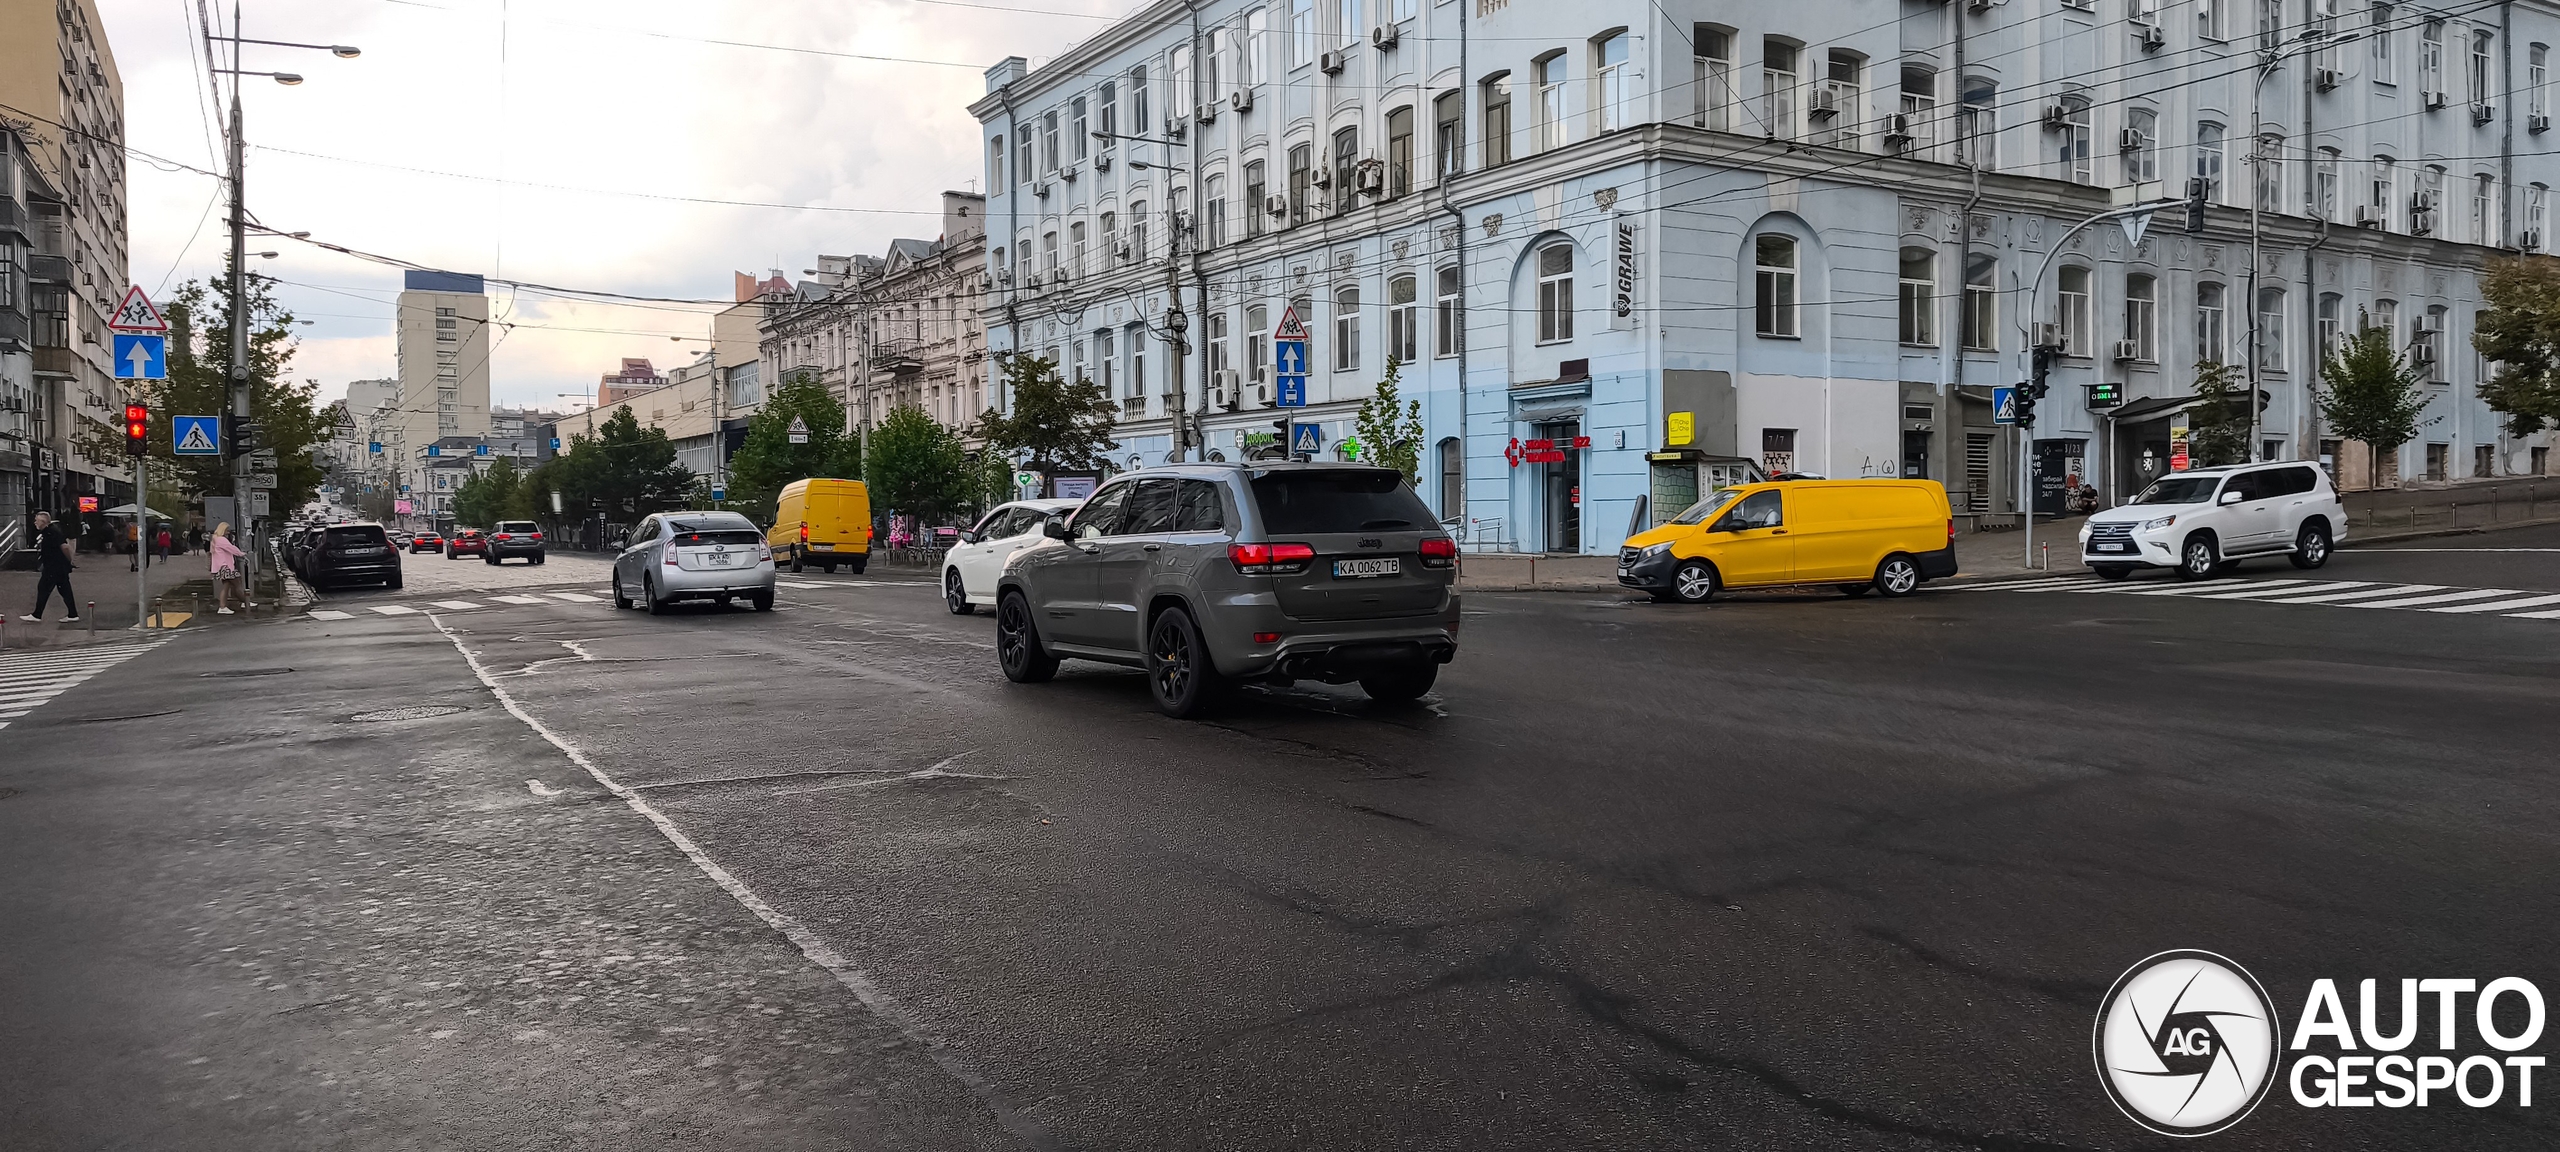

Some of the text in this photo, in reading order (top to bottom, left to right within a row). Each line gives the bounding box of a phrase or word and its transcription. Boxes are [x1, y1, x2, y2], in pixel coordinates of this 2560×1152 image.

[1618, 222, 1633, 293] GRAWE
[1357, 537, 1382, 549] Jeep
[1340, 560, 1399, 575] KA 0062 TB
